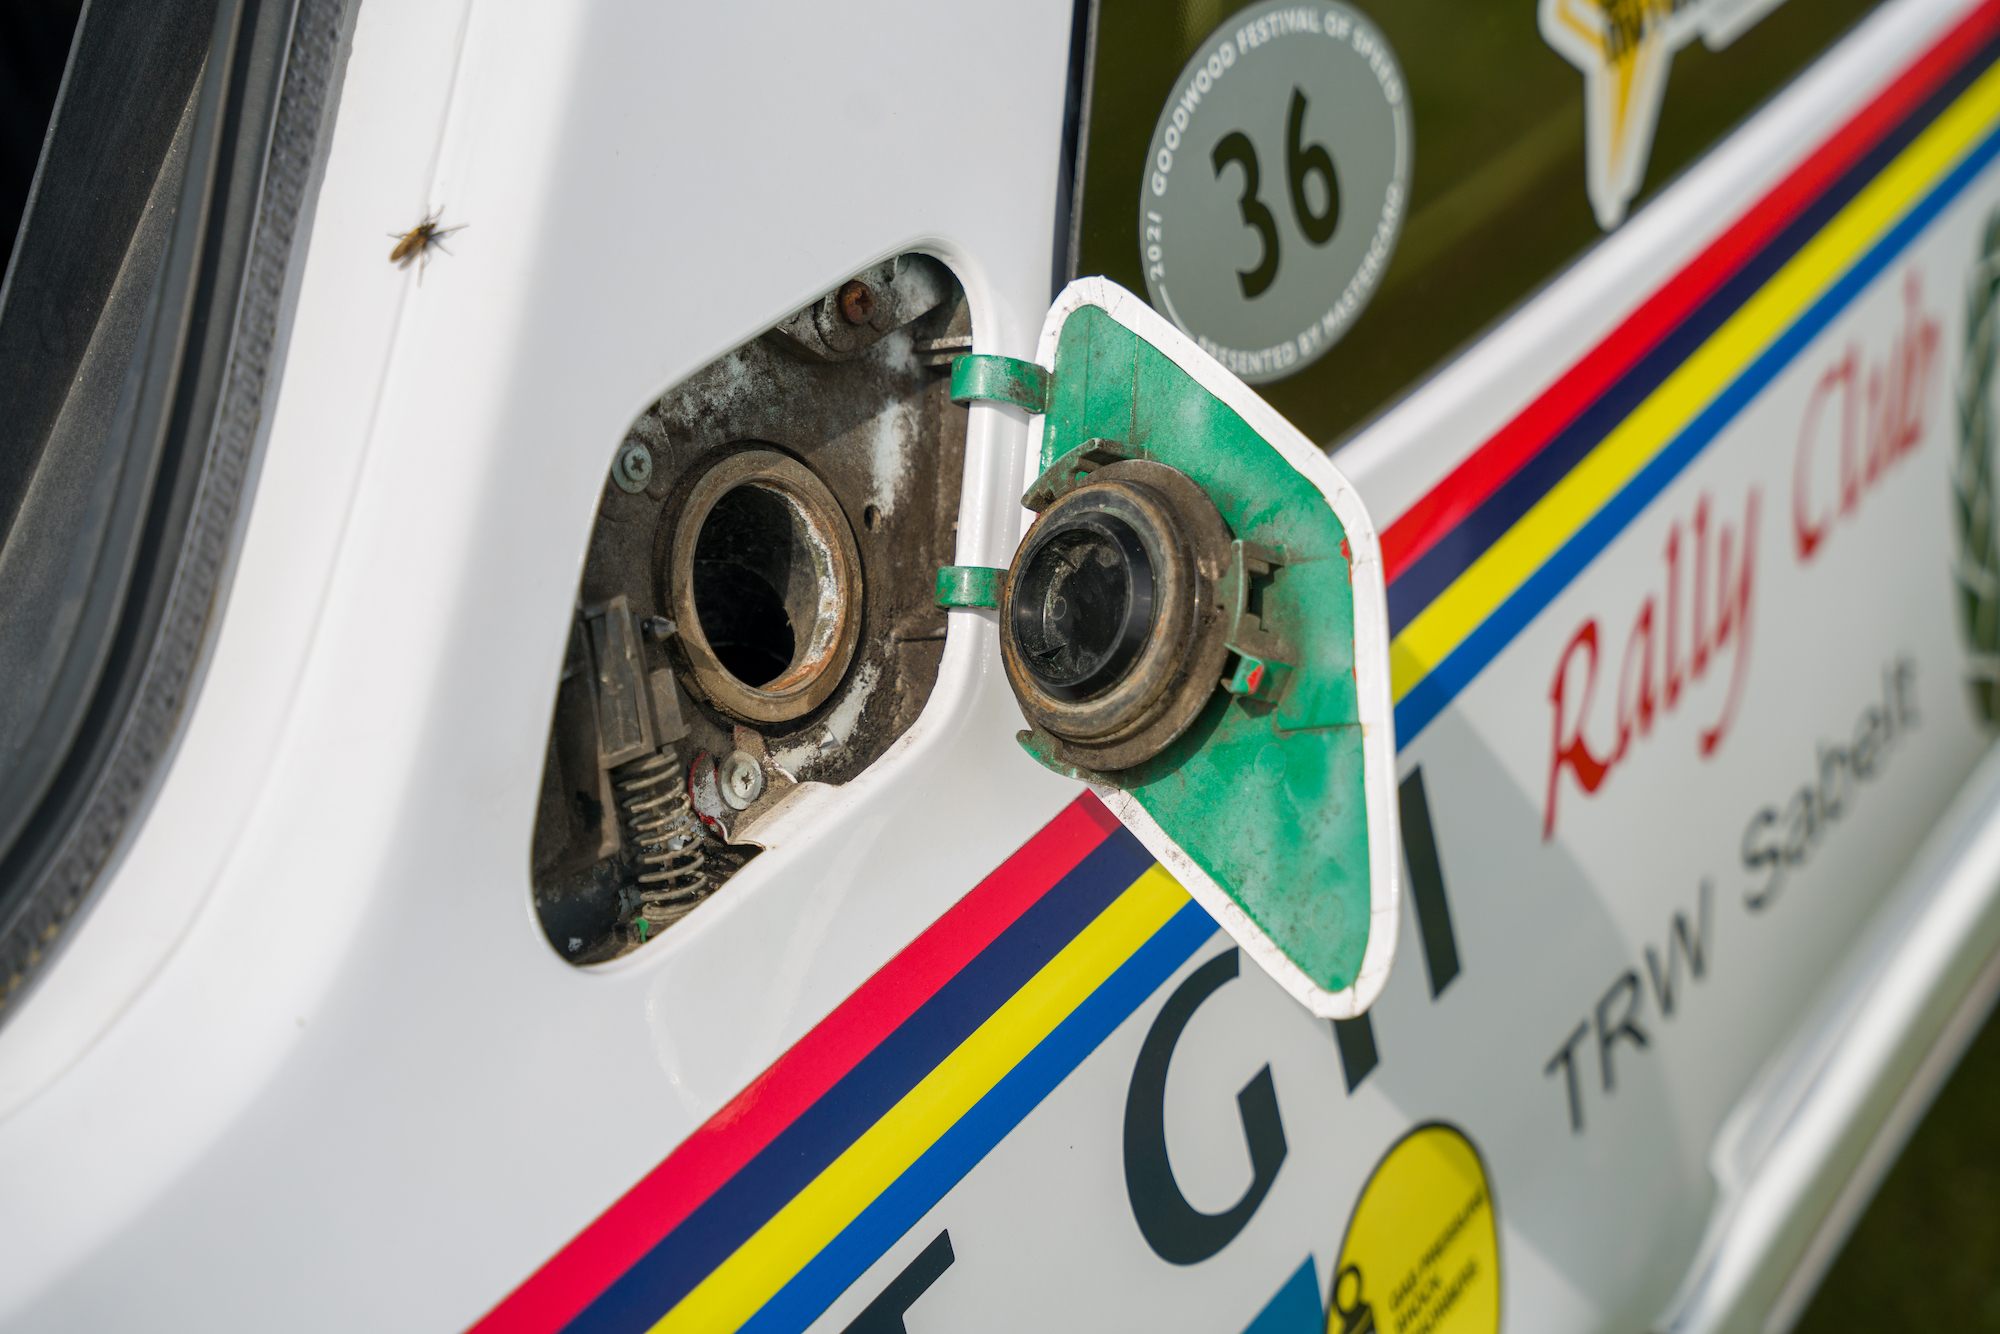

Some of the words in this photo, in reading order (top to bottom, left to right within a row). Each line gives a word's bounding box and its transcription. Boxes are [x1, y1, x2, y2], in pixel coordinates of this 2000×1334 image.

[1236, 7, 1321, 54] FESTIVAL
[1323, 9, 1351, 41] OF
[1151, 41, 1237, 197] GOODWOOD
[1146, 211, 1164, 282] 2021
[1209, 84, 1341, 302] 36
[1298, 323, 1323, 357] BY
[1544, 484, 1760, 844] Rally
[1793, 268, 1942, 566] Club
[1544, 878, 1714, 1133] TRW
[1739, 652, 1920, 912] Sabelt
